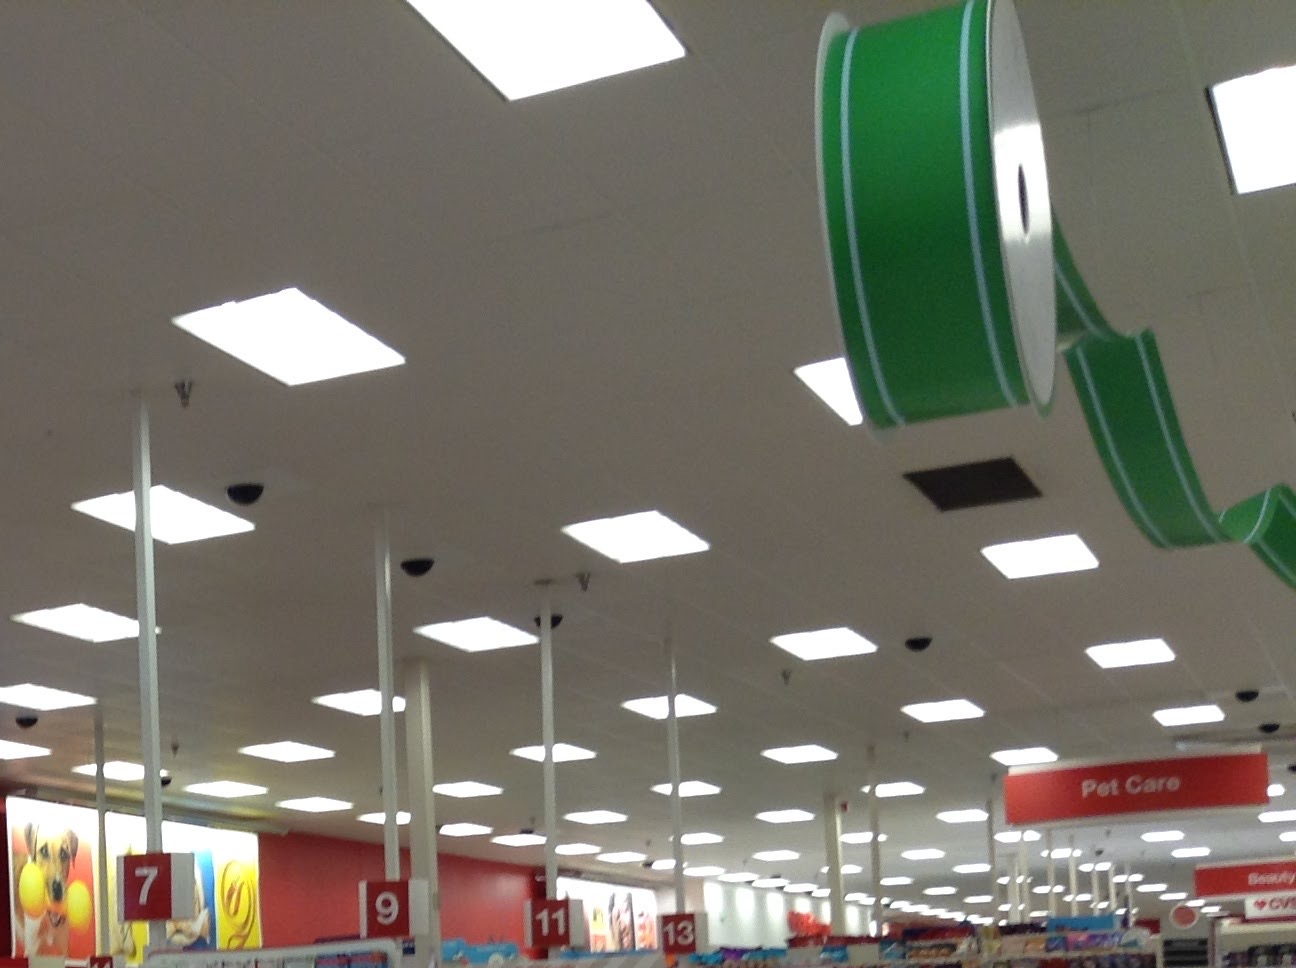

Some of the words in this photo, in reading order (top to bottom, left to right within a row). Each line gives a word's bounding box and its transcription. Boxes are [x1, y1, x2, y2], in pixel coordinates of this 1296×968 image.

[1081, 779, 1119, 799] Pet
[1125, 774, 1182, 795] Care
[134, 866, 159, 906] 7
[375, 891, 400, 926] 9
[535, 908, 569, 937] 11
[663, 920, 696, 947] 13
